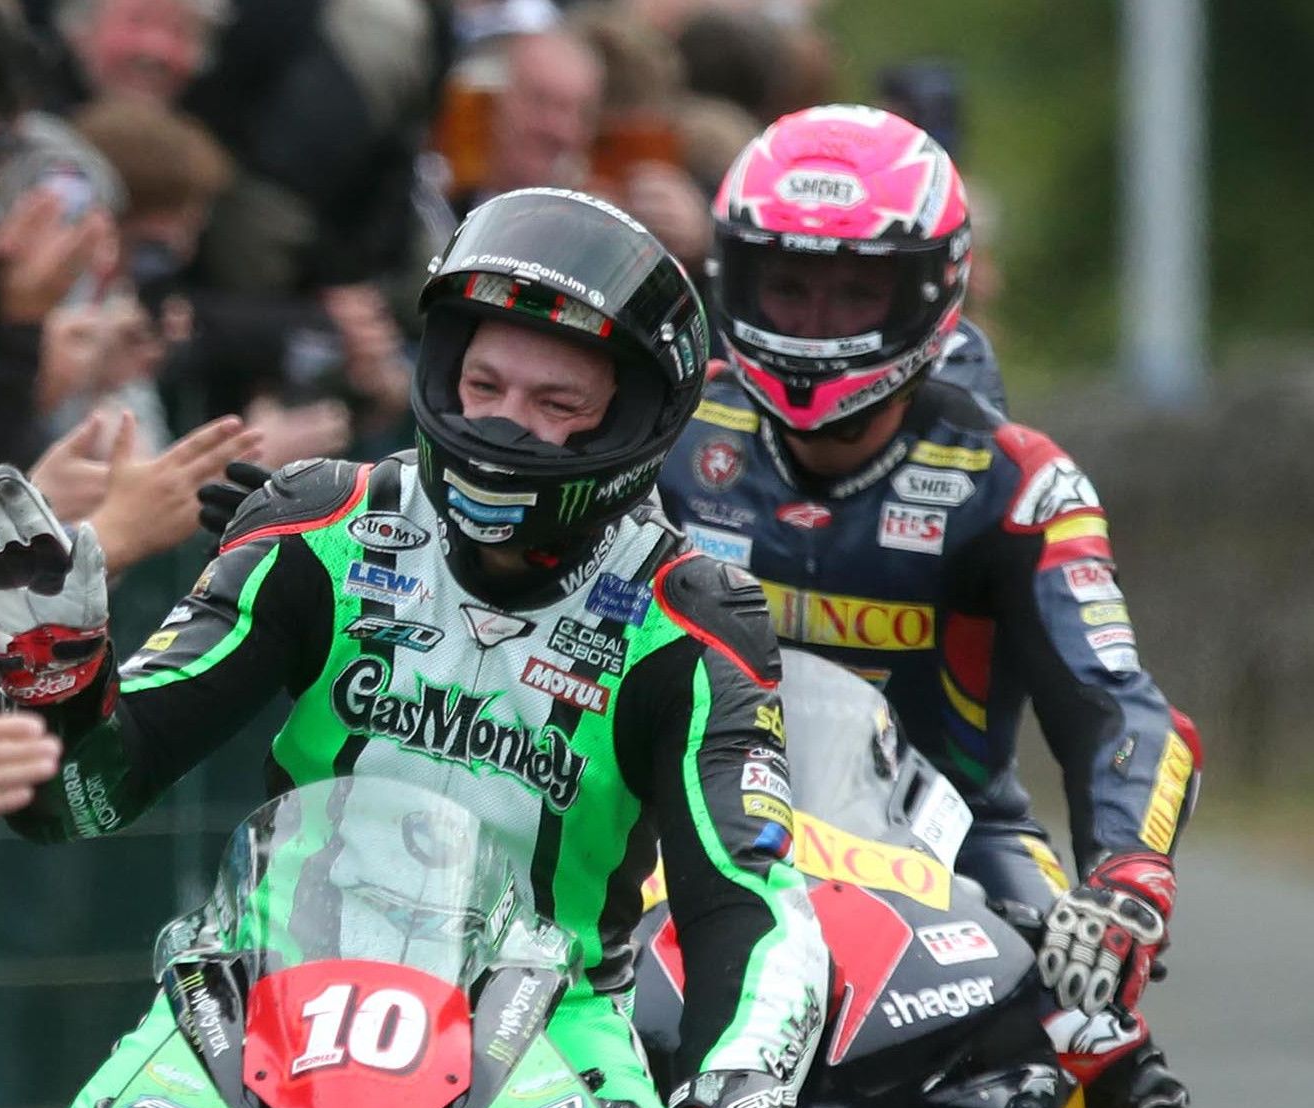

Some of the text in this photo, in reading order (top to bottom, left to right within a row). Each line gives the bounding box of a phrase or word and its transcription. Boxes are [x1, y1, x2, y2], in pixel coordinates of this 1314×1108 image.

[478, 253, 588, 295] CasinoCoin.im
[347, 562, 416, 593] LEW
[559, 522, 618, 596] Weise
[550, 636, 622, 673] ROBOTS
[558, 619, 624, 656] GLOBAL
[525, 663, 606, 713] MOTUL
[333, 655, 586, 810] GasMonkey
[291, 984, 428, 1075] 10
